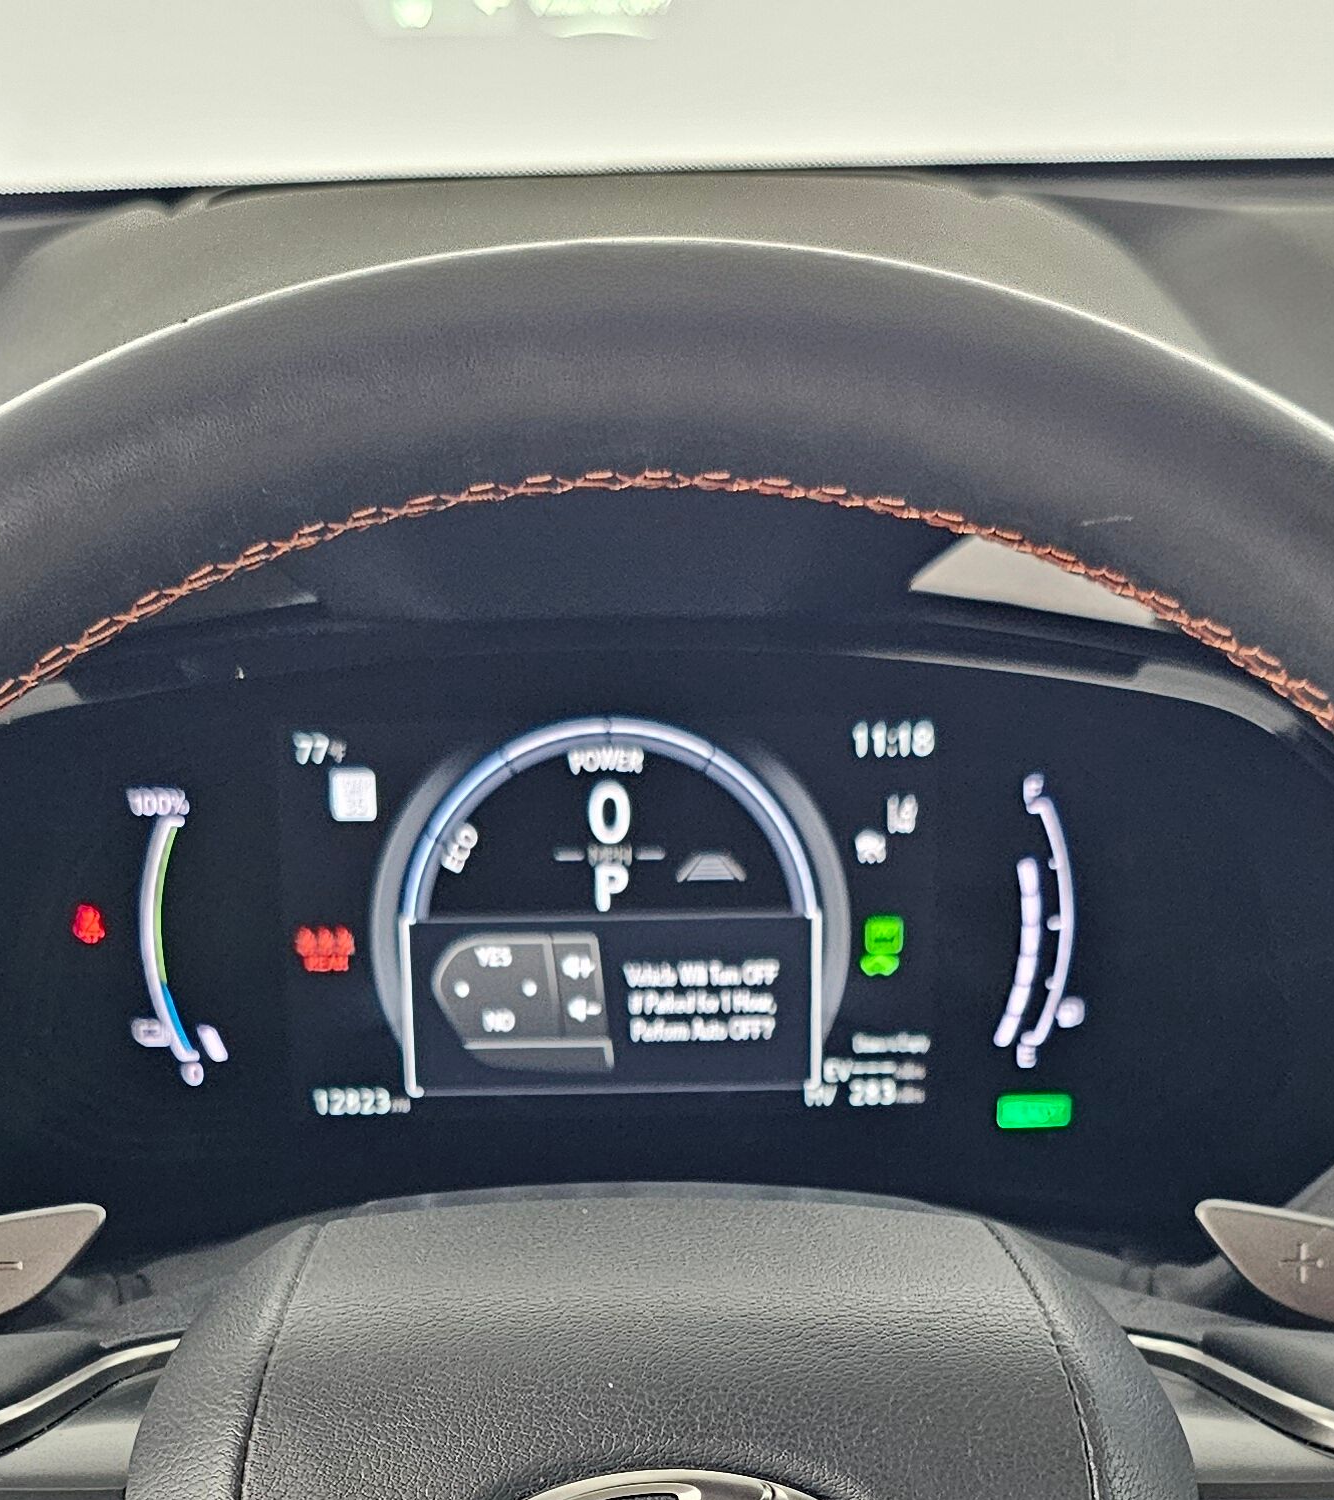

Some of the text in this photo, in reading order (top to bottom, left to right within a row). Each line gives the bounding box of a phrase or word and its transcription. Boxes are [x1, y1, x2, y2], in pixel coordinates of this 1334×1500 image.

[568, 747, 644, 776] POWER
[126, 787, 190, 817] 100%
[588, 779, 631, 845] 0
[595, 862, 629, 912] P
